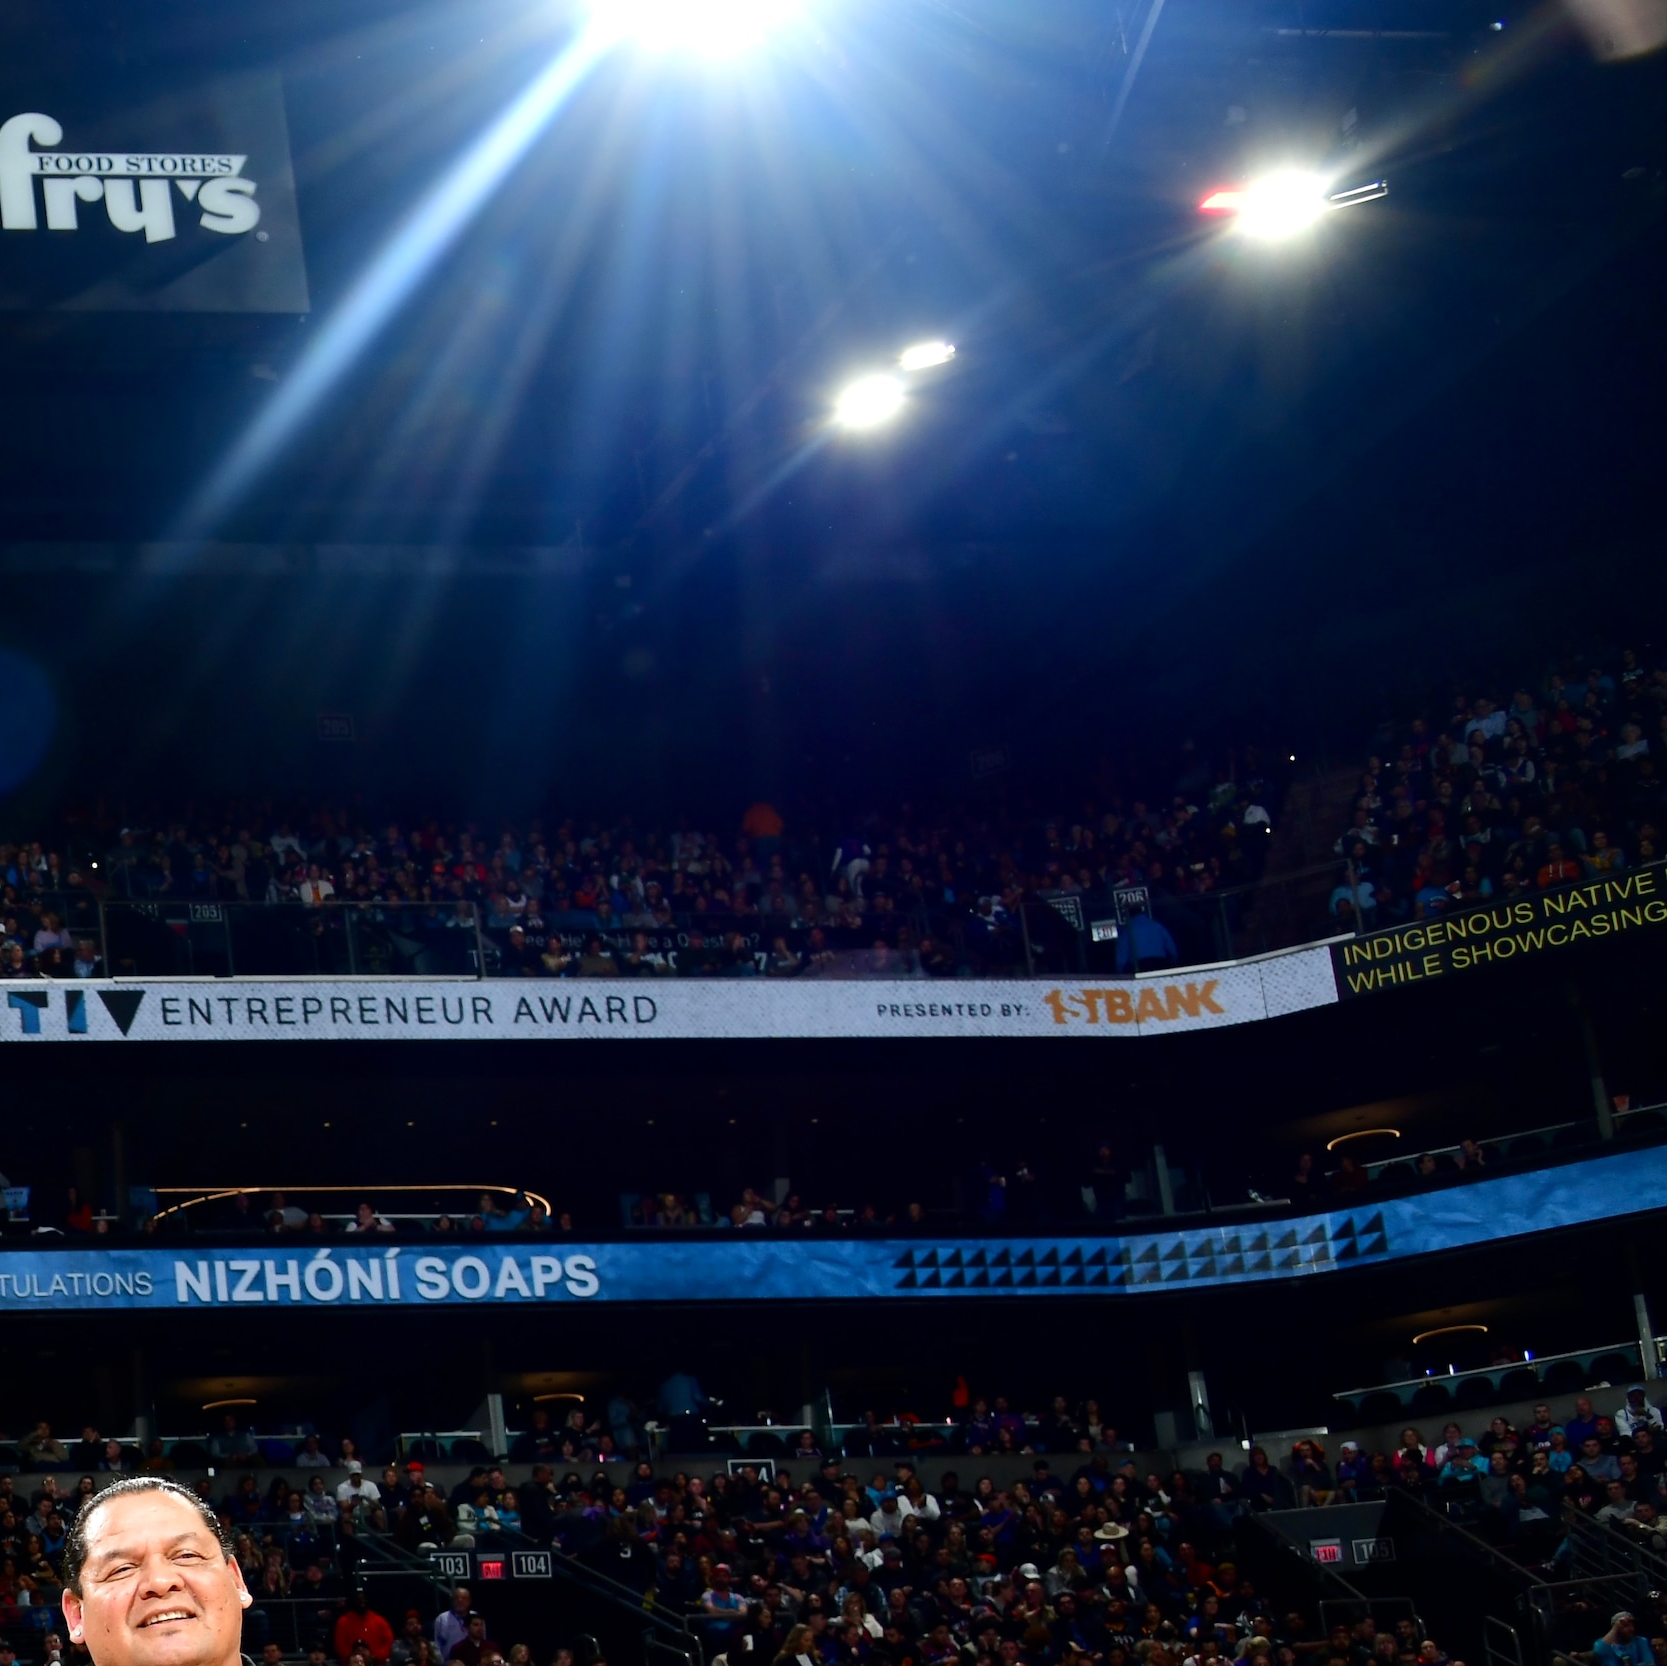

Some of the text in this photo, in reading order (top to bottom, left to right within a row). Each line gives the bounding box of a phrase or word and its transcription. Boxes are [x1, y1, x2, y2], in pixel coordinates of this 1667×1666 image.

[37, 152, 234, 175] FOOD STORES
[1343, 868, 1657, 967] INDIGENOUS NATIVE
[1346, 901, 1667, 995] WHILE SHOWCASING
[161, 995, 494, 1028] ENTREPRENEUR
[513, 995, 659, 1026] AWARD
[876, 1003, 994, 1019] PRESENTED
[1000, 1003, 1031, 1018] BY:
[175, 1248, 401, 1304] NIZHÓNÍ
[415, 1254, 600, 1300] SOAPS
[438, 1555, 465, 1575] 103
[518, 1555, 547, 1575] 104
